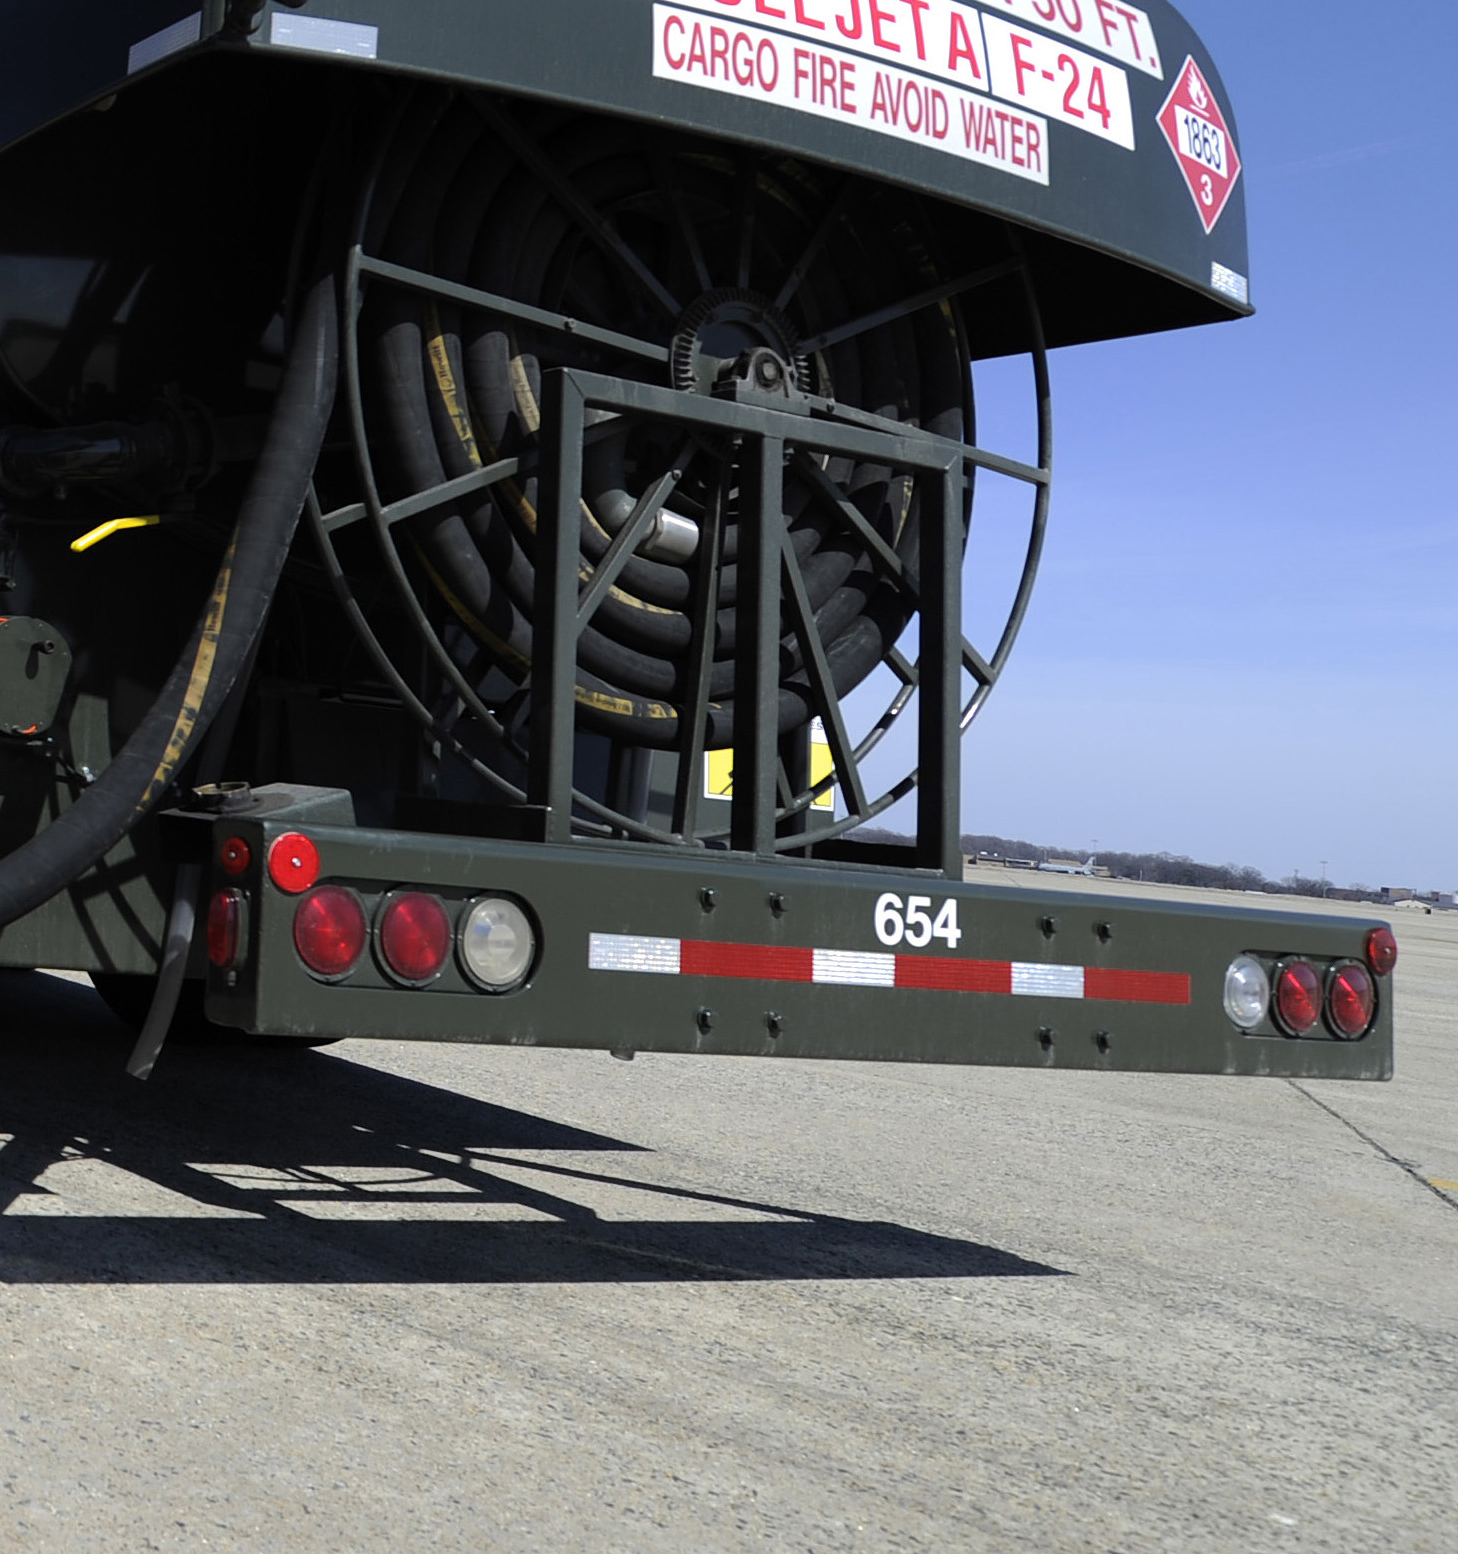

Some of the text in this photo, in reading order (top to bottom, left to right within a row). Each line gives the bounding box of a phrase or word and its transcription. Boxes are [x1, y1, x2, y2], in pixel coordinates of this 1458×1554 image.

[947, 11, 982, 80] A
[663, 15, 779, 92] CARGO
[793, 47, 857, 114] FIRE
[870, 71, 949, 140] AVOID
[960, 98, 1042, 173] WATER
[1009, 32, 1111, 130] F-24
[1184, 114, 1221, 170] 1863
[1200, 173, 1213, 206] 3
[874, 892, 962, 949] 654
